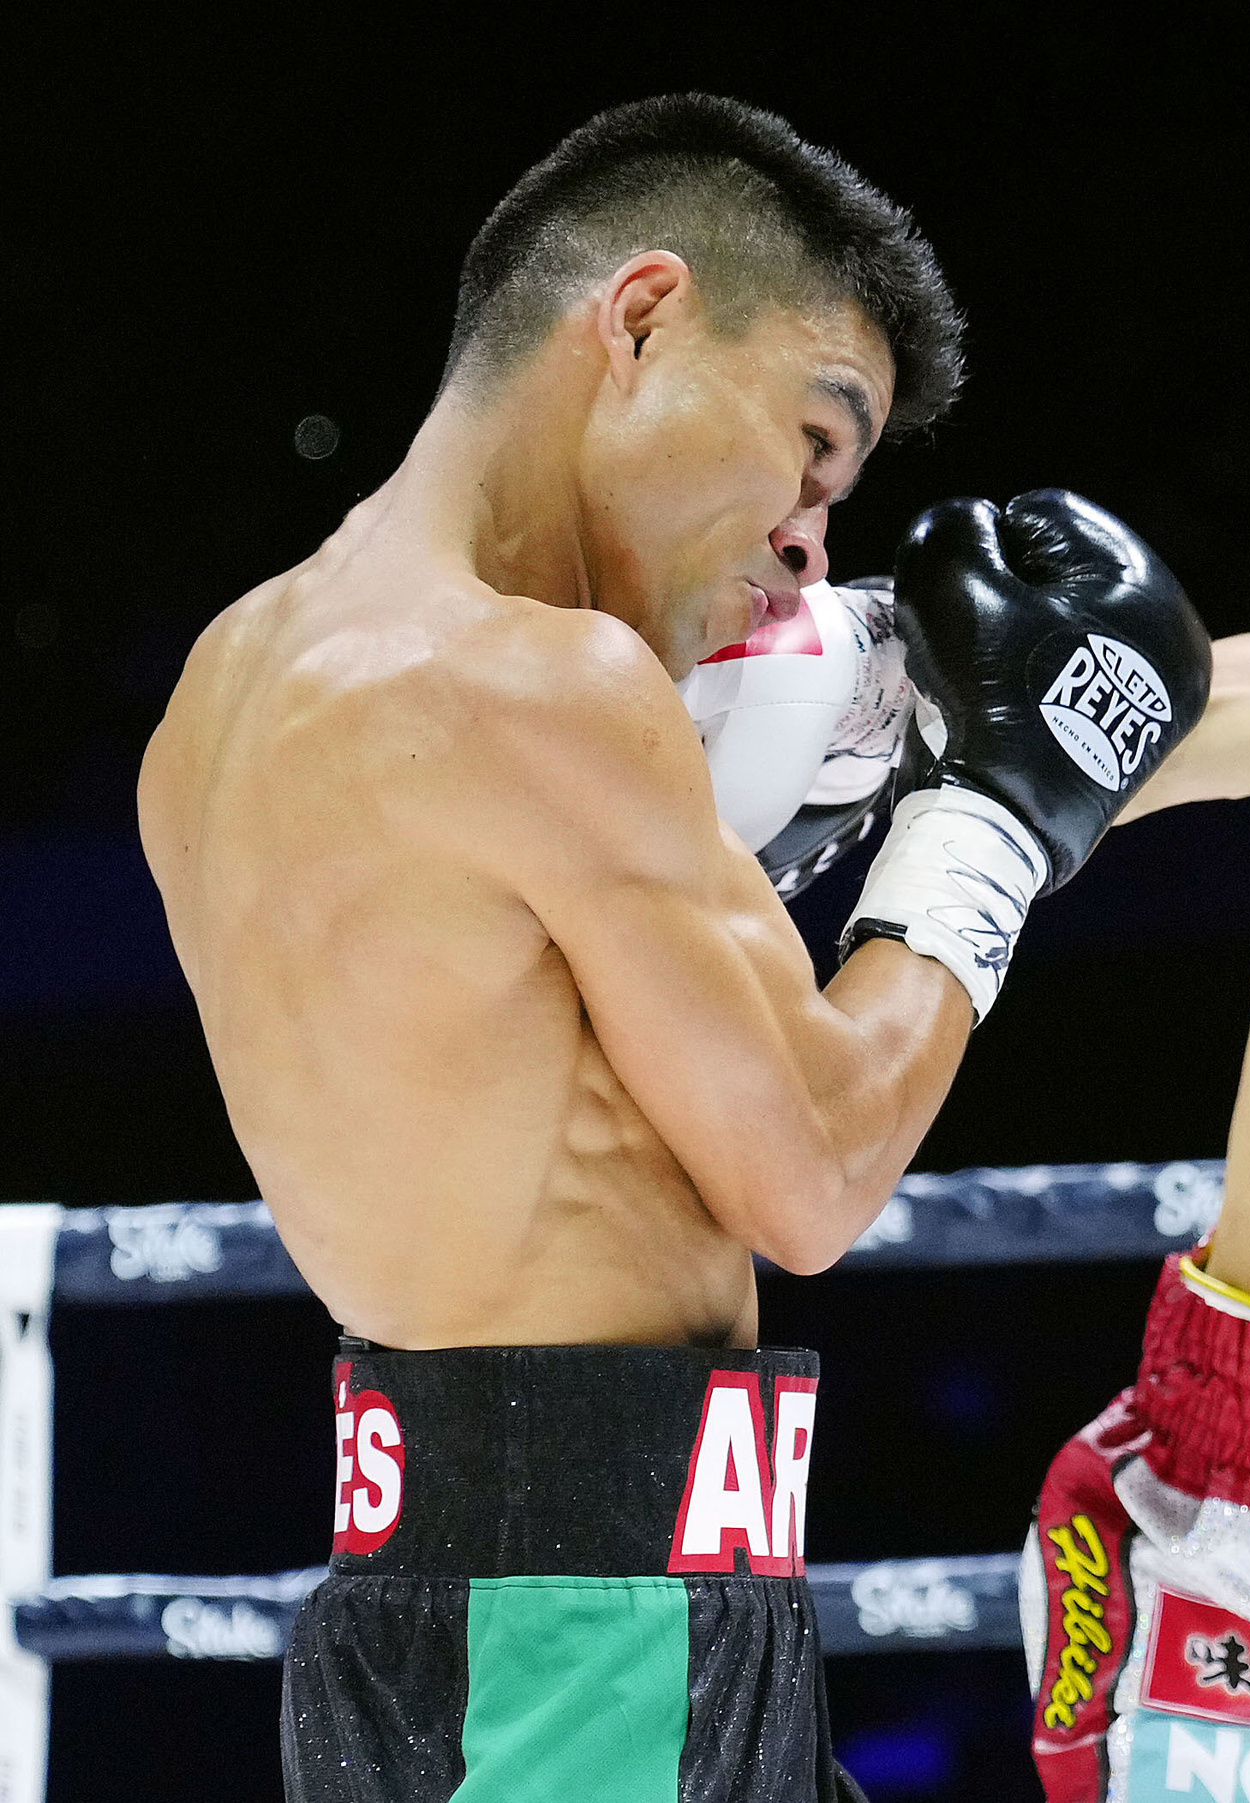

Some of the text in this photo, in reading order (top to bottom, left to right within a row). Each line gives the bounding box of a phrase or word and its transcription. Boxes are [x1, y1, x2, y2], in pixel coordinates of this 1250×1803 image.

[1041, 646, 1162, 775] REYES
[1102, 643, 1167, 712] CLETO
[1052, 715, 1115, 782] HECHO EN MEXICO
[681, 1387, 816, 1558] AR
